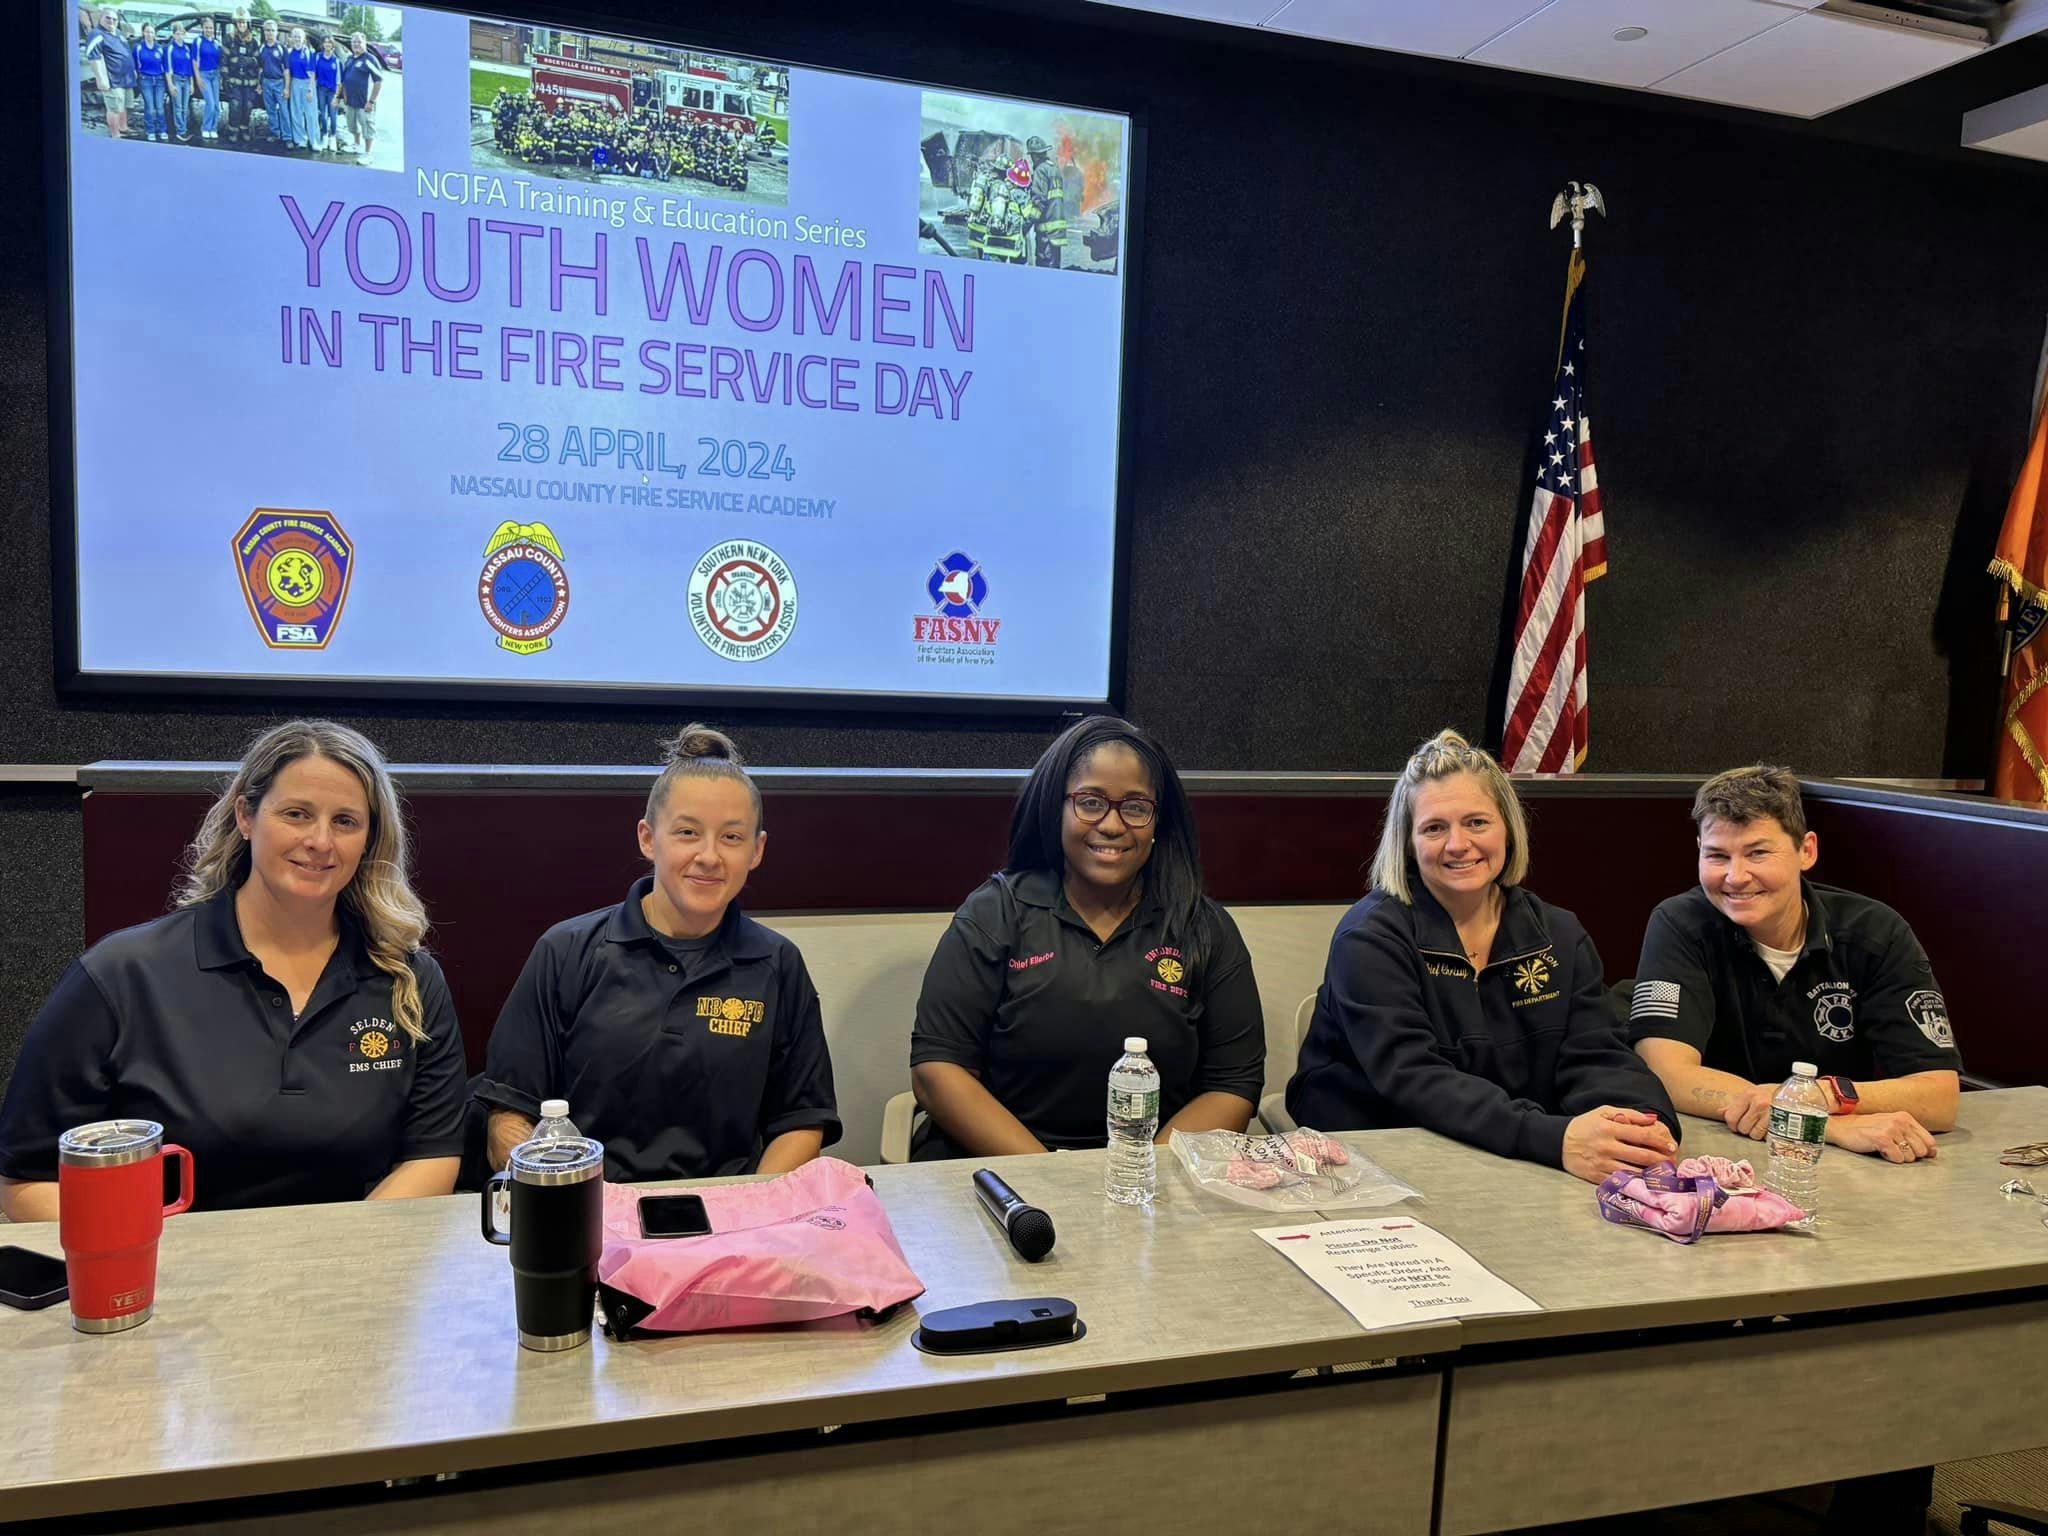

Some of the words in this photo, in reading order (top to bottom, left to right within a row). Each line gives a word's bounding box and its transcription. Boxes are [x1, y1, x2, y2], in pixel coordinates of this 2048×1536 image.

[416, 168, 508, 207] NCJFA
[513, 180, 625, 228] Training
[632, 197, 655, 225] &
[661, 199, 788, 242] Education
[794, 215, 867, 248] Series
[279, 195, 608, 316] YOUTH
[636, 237, 975, 353] WOMEN
[281, 306, 342, 368] IN
[359, 313, 483, 381] THE
[501, 327, 625, 392] FIRE
[639, 340, 860, 413] SERVICE
[874, 362, 973, 421] DAY
[497, 422, 550, 464] 28
[558, 426, 687, 479] APRIL,
[697, 437, 797, 481] 2024
[449, 474, 532, 499] NASSAU
[536, 480, 617, 505] COUNTY
[620, 484, 663, 509] FIRE
[665, 488, 743, 514] SERVICE
[746, 493, 838, 520] ACADEMY
[482, 548, 523, 582] NASSAU
[525, 548, 565, 587] COUNTY
[698, 544, 744, 578] SOUTHERN
[746, 544, 770, 564] NEW
[767, 557, 790, 585] YORK
[482, 597, 523, 636] FIREFIGHTERS
[524, 600, 566, 637] ASSOCIATION
[690, 592, 721, 648] VOLUNTEER
[719, 630, 783, 659] FIREFIGHTERS
[277, 626, 318, 641] FSA
[913, 616, 1001, 644] FASNY
[504, 640, 522, 650] NEW
[524, 640, 545, 651] YORK
[1009, 958, 1028, 968] Chief
[1806, 982, 1849, 999] BATTALION
[350, 1018, 396, 1035] SELDEN
[708, 1018, 752, 1037] CHIEF
[348, 1042, 356, 1053] F
[393, 1040, 400, 1049] D
[349, 1063, 370, 1073] EMS
[373, 1059, 403, 1070] CHIEF
[1325, 1242, 1361, 1250] Please
[1325, 1247, 1381, 1256] Rearrange
[1380, 1243, 1418, 1251] Tables
[1334, 1264, 1364, 1273] They
[1385, 1259, 1421, 1267] Wired
[1346, 1270, 1390, 1280] Specific
[1367, 1277, 1407, 1285] Should
[1408, 1274, 1434, 1282] NOT
[1408, 1297, 1447, 1308] Thank
